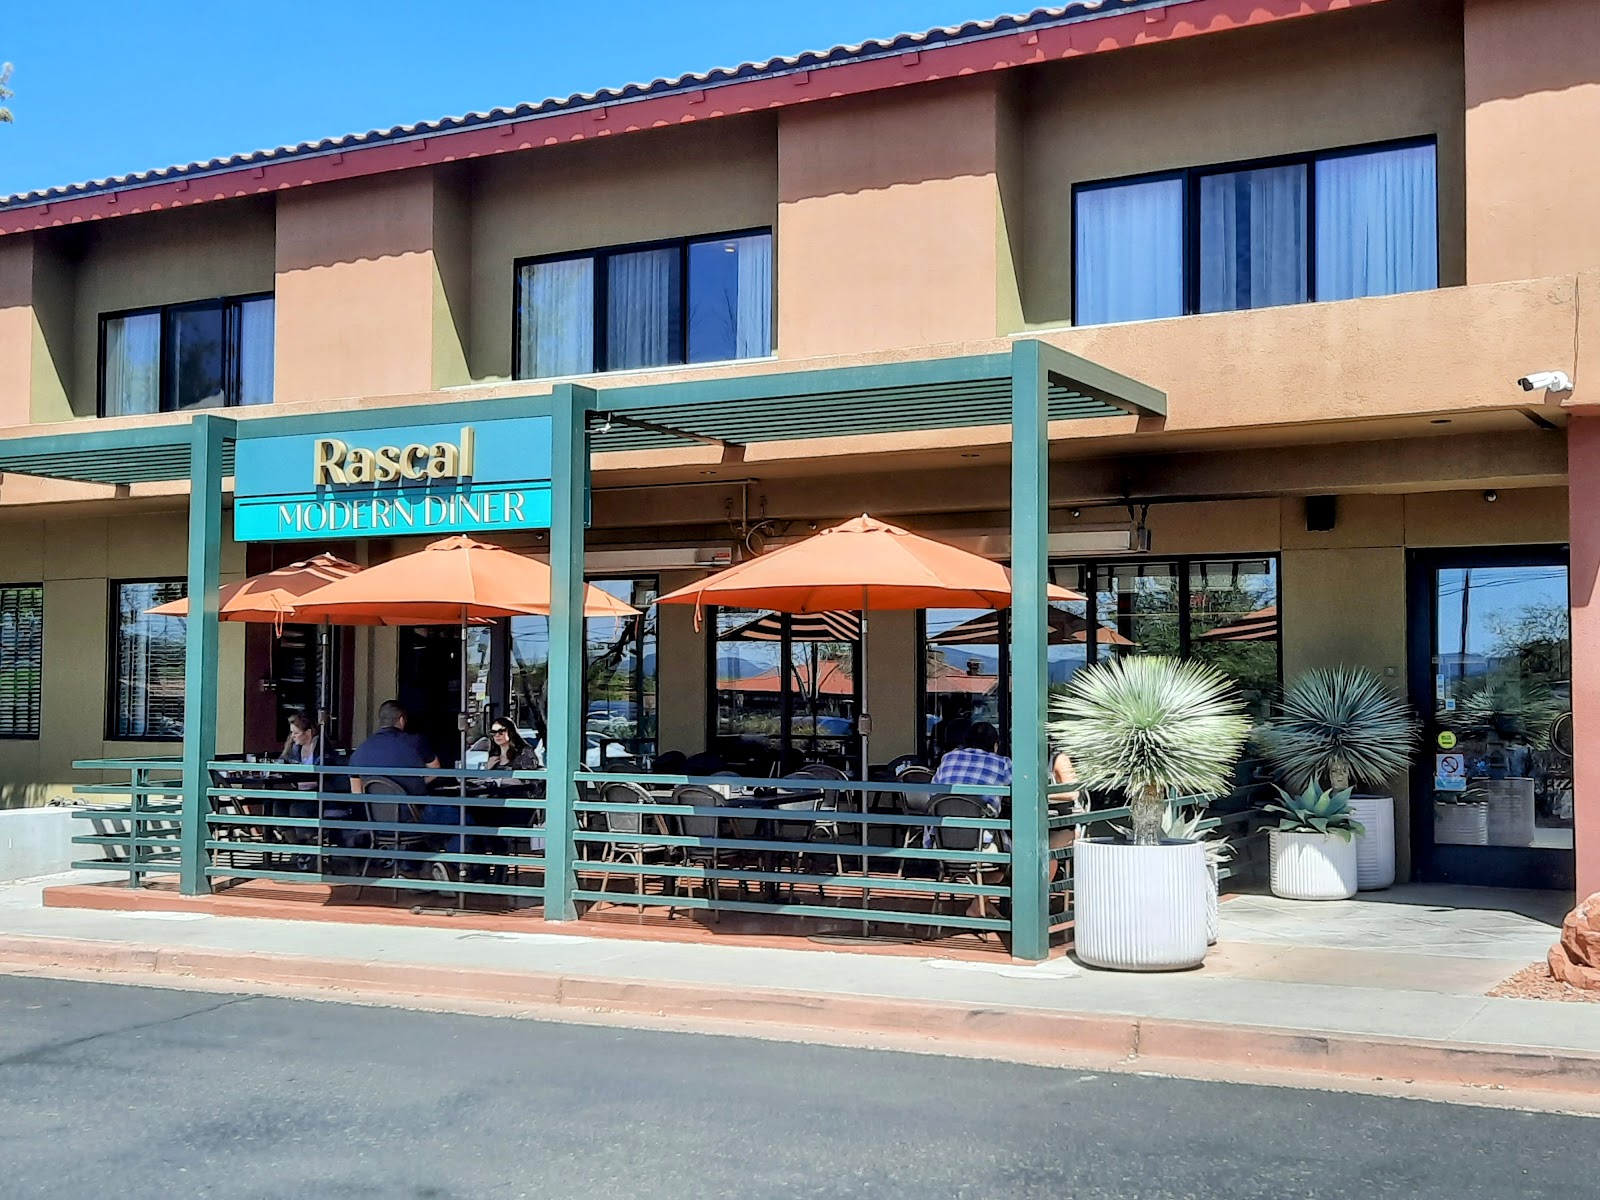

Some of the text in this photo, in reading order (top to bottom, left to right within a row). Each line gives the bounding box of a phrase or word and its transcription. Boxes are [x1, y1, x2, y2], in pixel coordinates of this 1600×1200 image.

[314, 426, 475, 486] Rascal
[278, 491, 526, 533] MODERN DINER
